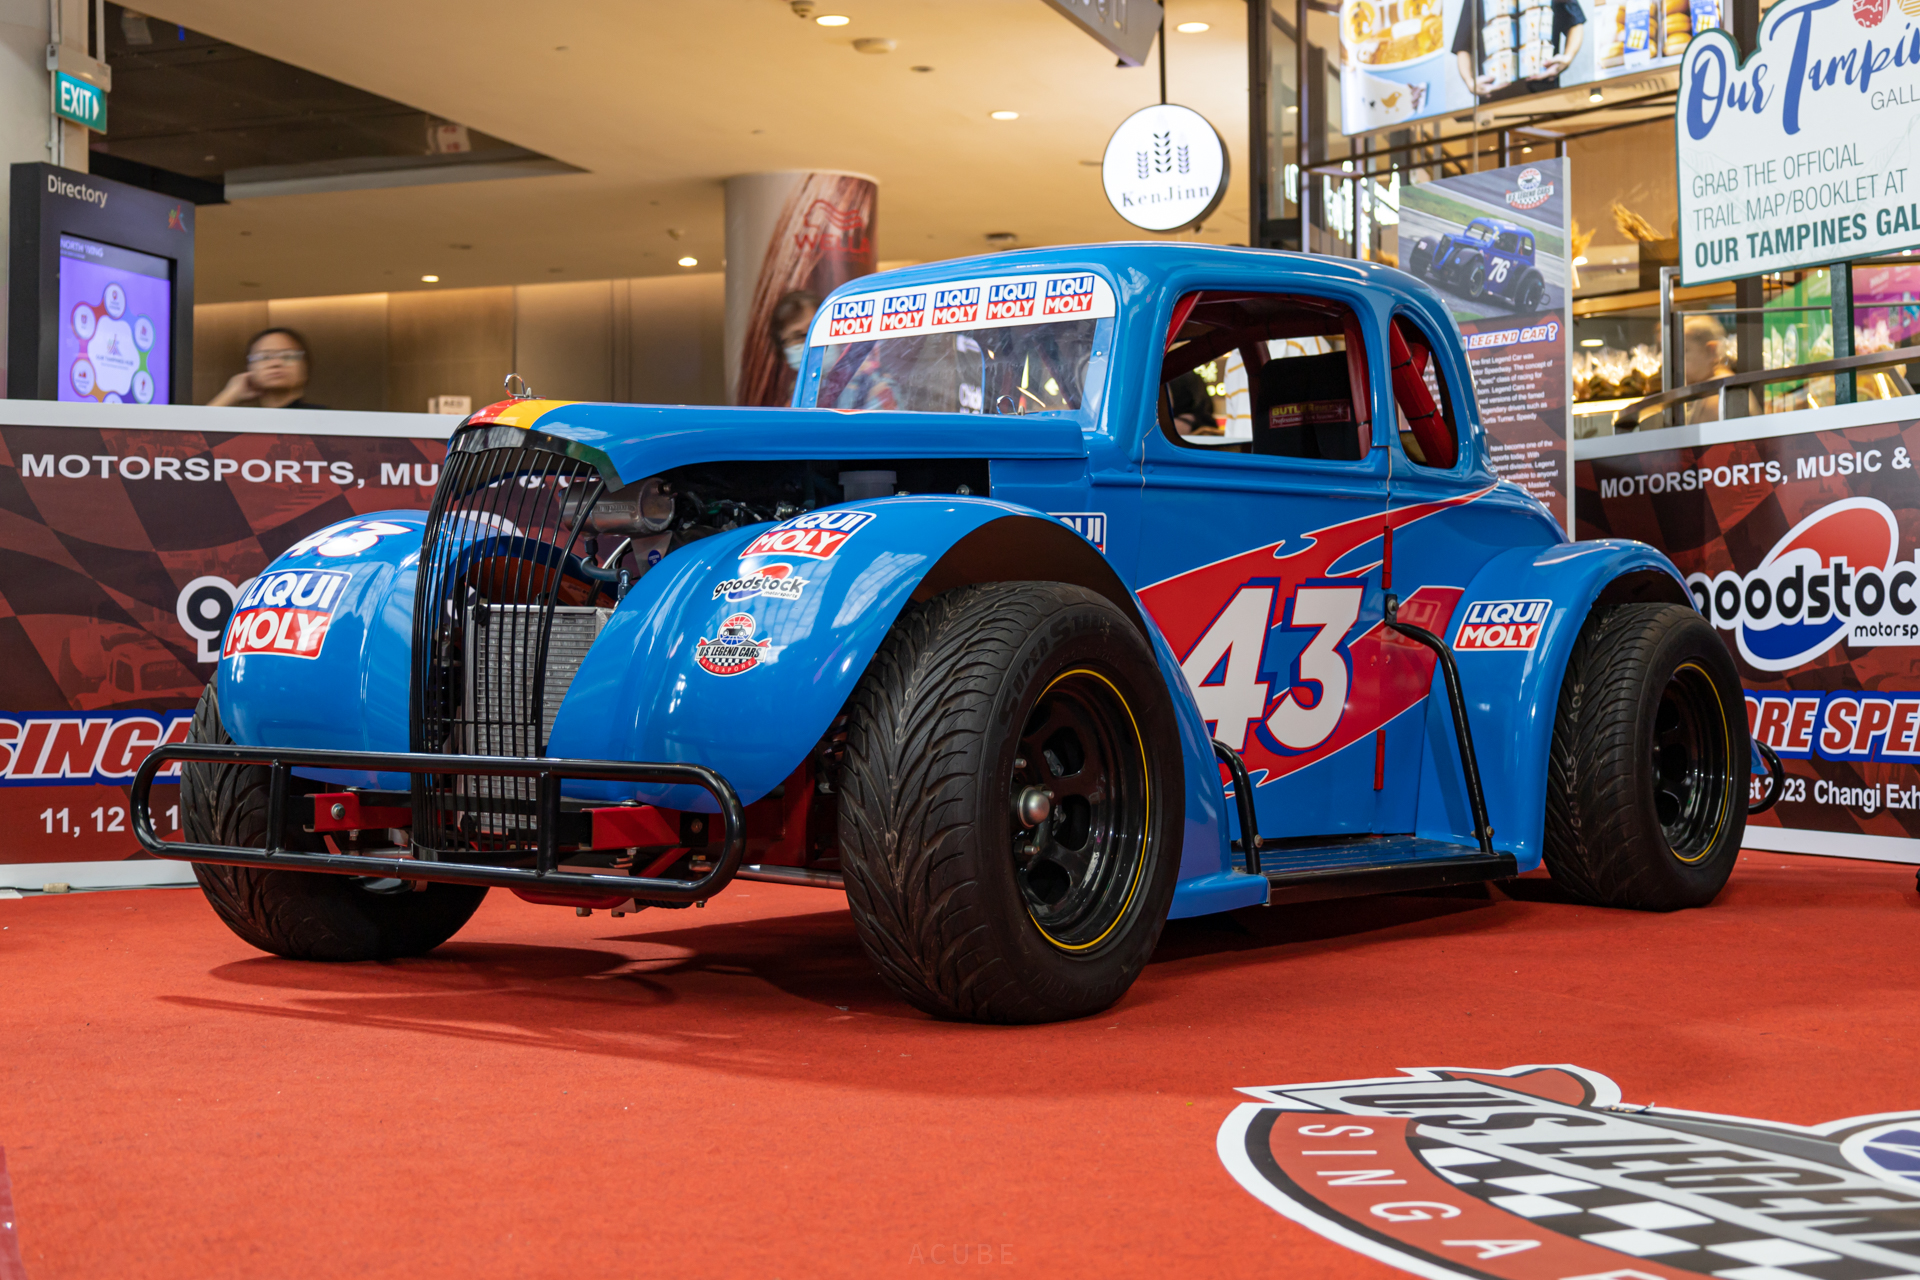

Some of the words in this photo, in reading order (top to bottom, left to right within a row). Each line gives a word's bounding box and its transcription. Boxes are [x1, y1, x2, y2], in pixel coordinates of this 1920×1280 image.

[61, 80, 92, 120] EXIT
[1686, 44, 1774, 141] Our
[1692, 168, 1739, 199] GRAB
[1743, 159, 1777, 188] THE
[1783, 142, 1864, 179] OFFICIAL
[48, 174, 108, 208] Directory
[1121, 184, 1210, 208] KenJinn
[1693, 202, 1741, 232] TRAIL
[1746, 174, 1879, 222] MAP/BOOKLET
[1884, 168, 1908, 196] AT
[794, 233, 870, 254] WELLA
[1695, 237, 1739, 268] OUR
[1746, 213, 1867, 259] TAMPINES
[1488, 256, 1511, 283] 76
[936, 288, 980, 307] LIQUI
[990, 282, 1037, 302] LIQUI
[1047, 276, 1094, 296] LIQUI
[833, 300, 875, 319] LIQUI
[883, 294, 926, 313] LIQUI
[933, 305, 977, 325] MOLY
[987, 300, 1034, 319] MOLY
[1045, 294, 1092, 314] MOLY
[830, 317, 873, 336] MOLY
[880, 311, 924, 330] MOLY
[1470, 331, 1519, 348] LEGEND
[21, 453, 366, 489] MOTORSPORTS,
[1601, 459, 1789, 499] MOTORSPORTS,
[1796, 449, 1882, 480] MUSIC
[1891, 446, 1912, 470] &
[769, 512, 867, 534] LIQUI
[283, 520, 415, 559] 43
[745, 529, 847, 555] MOLY
[240, 572, 343, 608] LIQUI
[714, 576, 804, 598] goodstock
[1468, 603, 1546, 624] LIQUI
[226, 610, 328, 653] MOLY
[1460, 625, 1539, 648] MOLY
[1854, 622, 1919, 639] motorsp
[710, 646, 739, 657] LEGEND
[738, 646, 761, 658] CARS
[701, 658, 754, 673] SINGAPORE
[1182, 579, 1366, 753] 43
[1819, 697, 1920, 756] SPE
[1764, 777, 1807, 803] 223
[1813, 779, 1881, 813] Changi
[40, 807, 81, 838] 11,
[91, 806, 125, 833] 12
